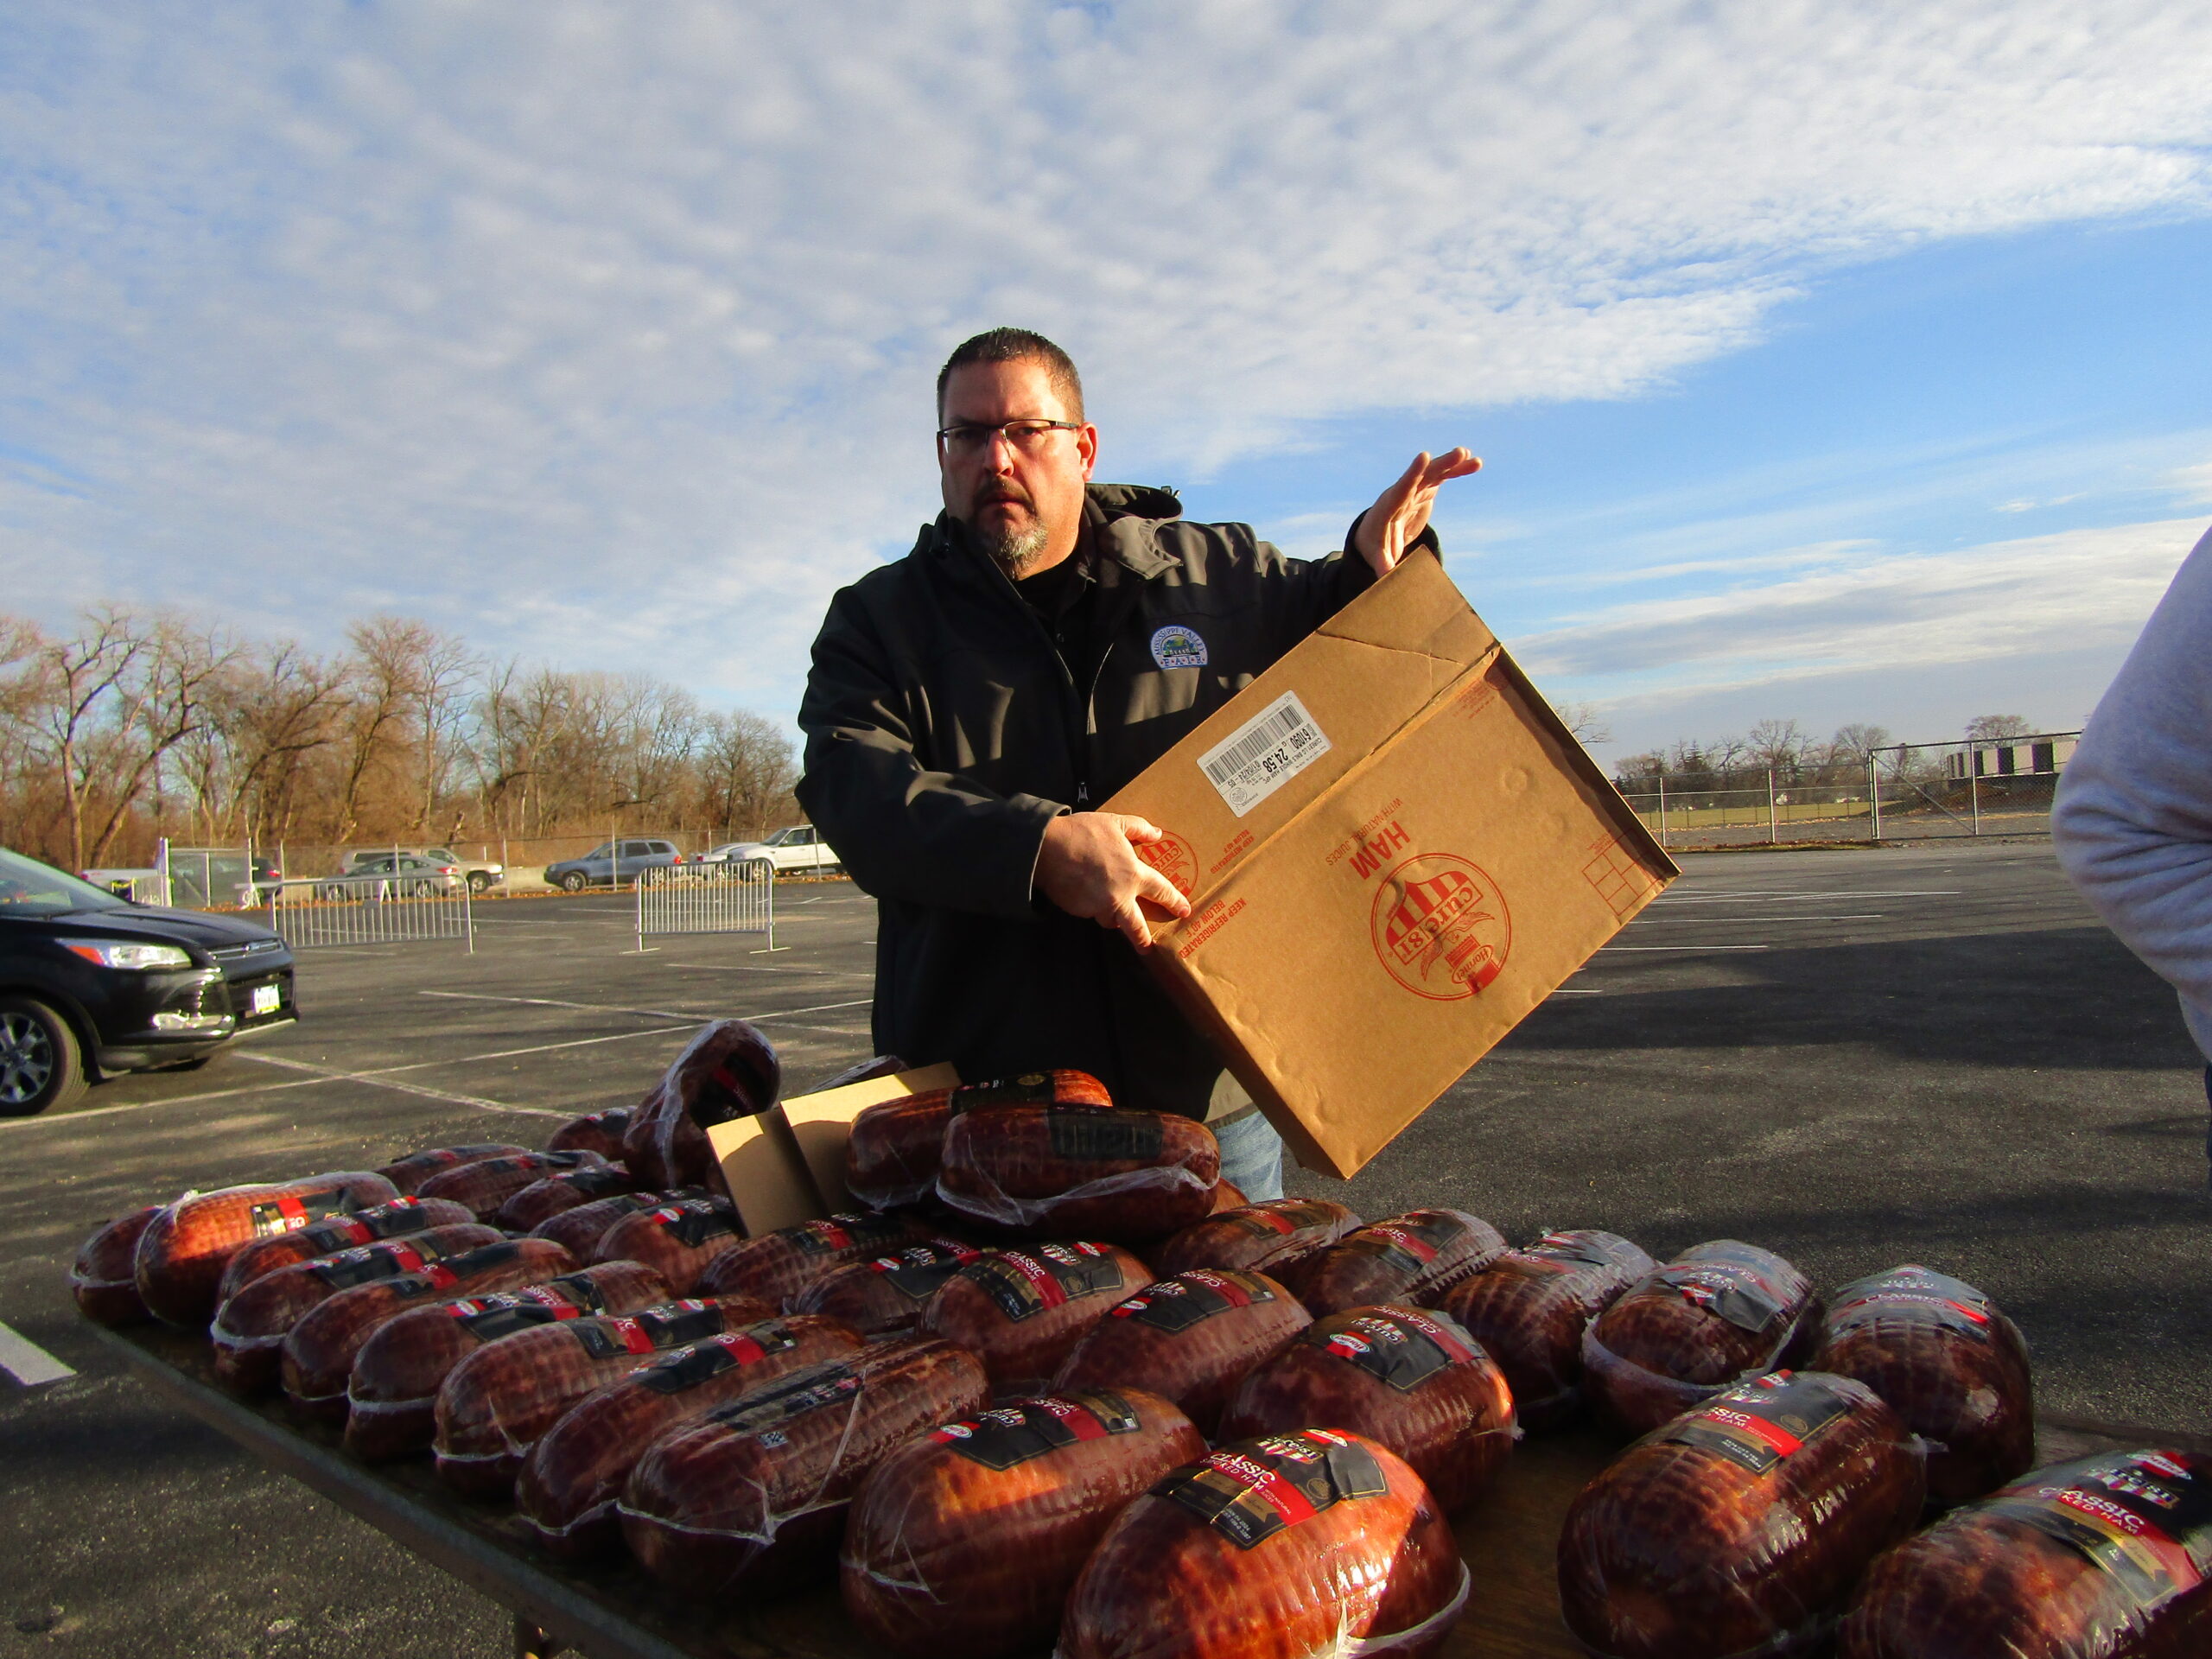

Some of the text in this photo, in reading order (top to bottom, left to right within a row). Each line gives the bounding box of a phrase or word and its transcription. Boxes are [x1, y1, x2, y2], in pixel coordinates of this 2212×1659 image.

[1181, 629, 1205, 652] VALLEY
[1288, 728, 1312, 749] 61090
[1261, 747, 1289, 773] 24.58
[1279, 759, 1293, 772] WHOLE
[1269, 768, 1281, 779] HAM
[1231, 828, 1249, 845] BELOW
[1324, 796, 1403, 867] WITH NATURAL JUICES
[1209, 835, 1254, 874] KEEP REFRIGERATED
[1347, 819, 1411, 880] HAM
[1198, 899, 1225, 924] BELOW
[1177, 897, 1247, 959] KEEP REFRIGERATED
[1454, 948, 1490, 981] Hormel
[1007, 1251, 1045, 1277] CLASSIC
[1374, 1306, 1437, 1334] CLASSIC
[1716, 1416, 1746, 1428] HAM
[1211, 1453, 1275, 1484] CLASSIC
[1241, 1473, 1264, 1491] HAM
[2062, 1494, 2138, 1535] KED HAM
